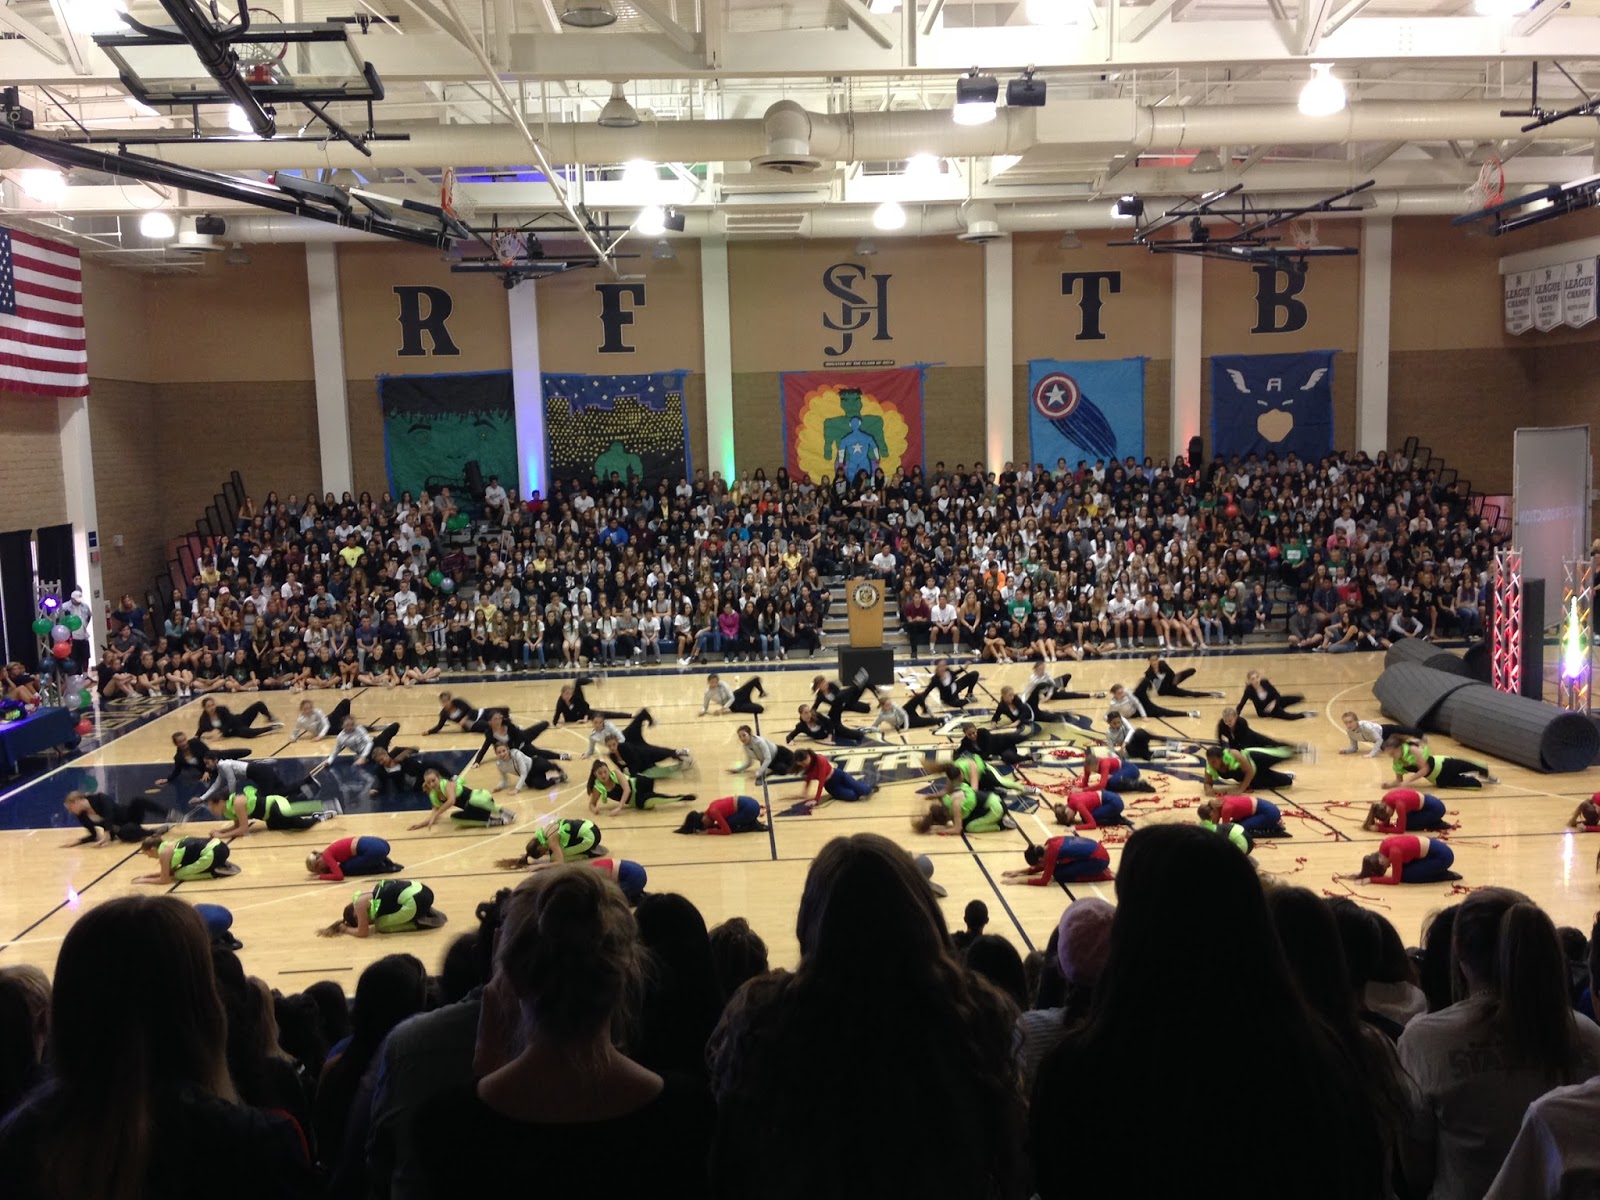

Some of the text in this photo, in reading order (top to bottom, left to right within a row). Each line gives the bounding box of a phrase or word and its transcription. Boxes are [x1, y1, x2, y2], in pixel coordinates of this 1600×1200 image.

[1250, 264, 1309, 334] B
[1505, 287, 1531, 299] LEAGUE
[1534, 282, 1561, 294] LEAGUE
[1565, 276, 1594, 290] LEAGUE
[391, 285, 462, 357] R
[594, 283, 647, 354] F
[1060, 270, 1122, 340] T
[1266, 378, 1282, 391] A
